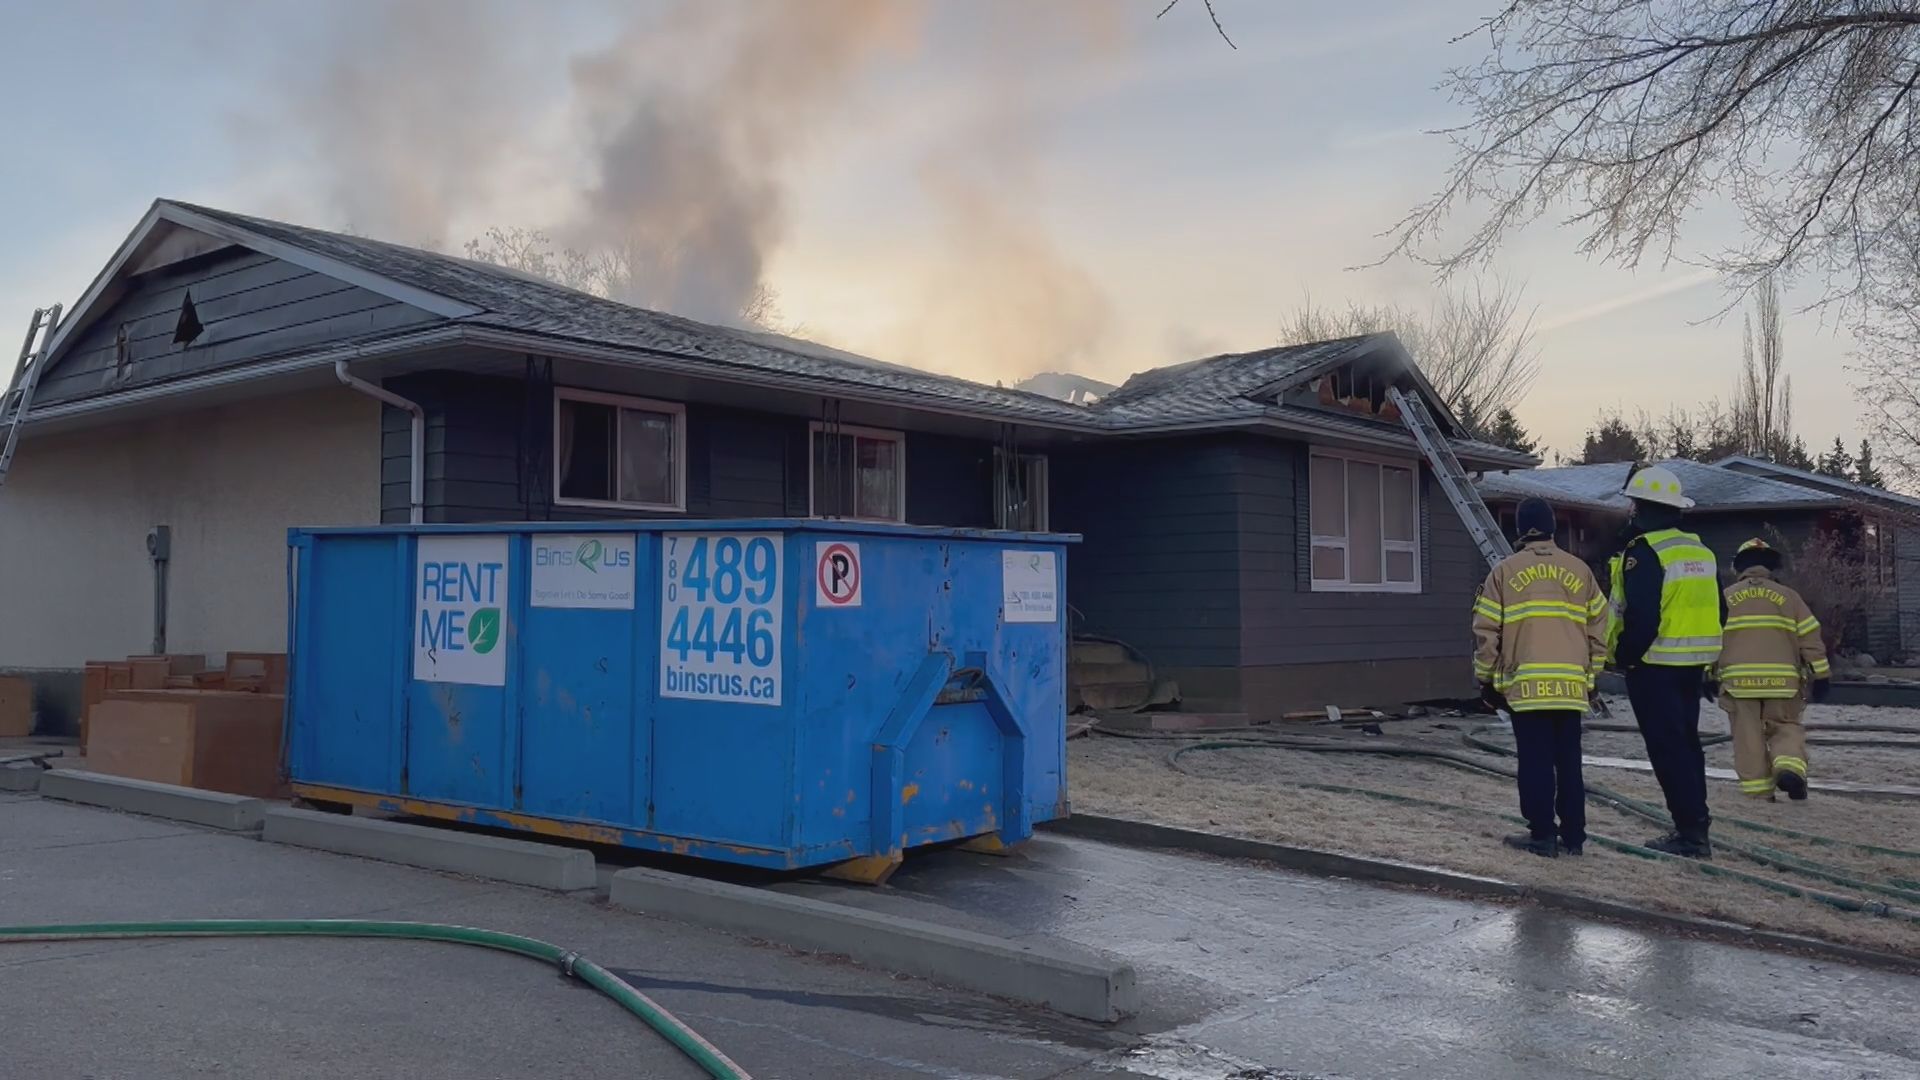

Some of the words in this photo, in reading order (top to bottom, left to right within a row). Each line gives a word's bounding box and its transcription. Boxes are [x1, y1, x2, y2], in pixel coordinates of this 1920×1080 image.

[535, 547, 572, 567] Bins
[604, 548, 631, 567] Us
[682, 537, 776, 605] 489
[423, 562, 503, 603] RENT
[1508, 563, 1584, 594] EDMONTON
[1728, 587, 1787, 606] EDMONTON
[421, 609, 465, 651] ME
[667, 605, 775, 667] 4446
[666, 665, 775, 698] binsrus.ca
[1537, 681, 1583, 698] BEATON
